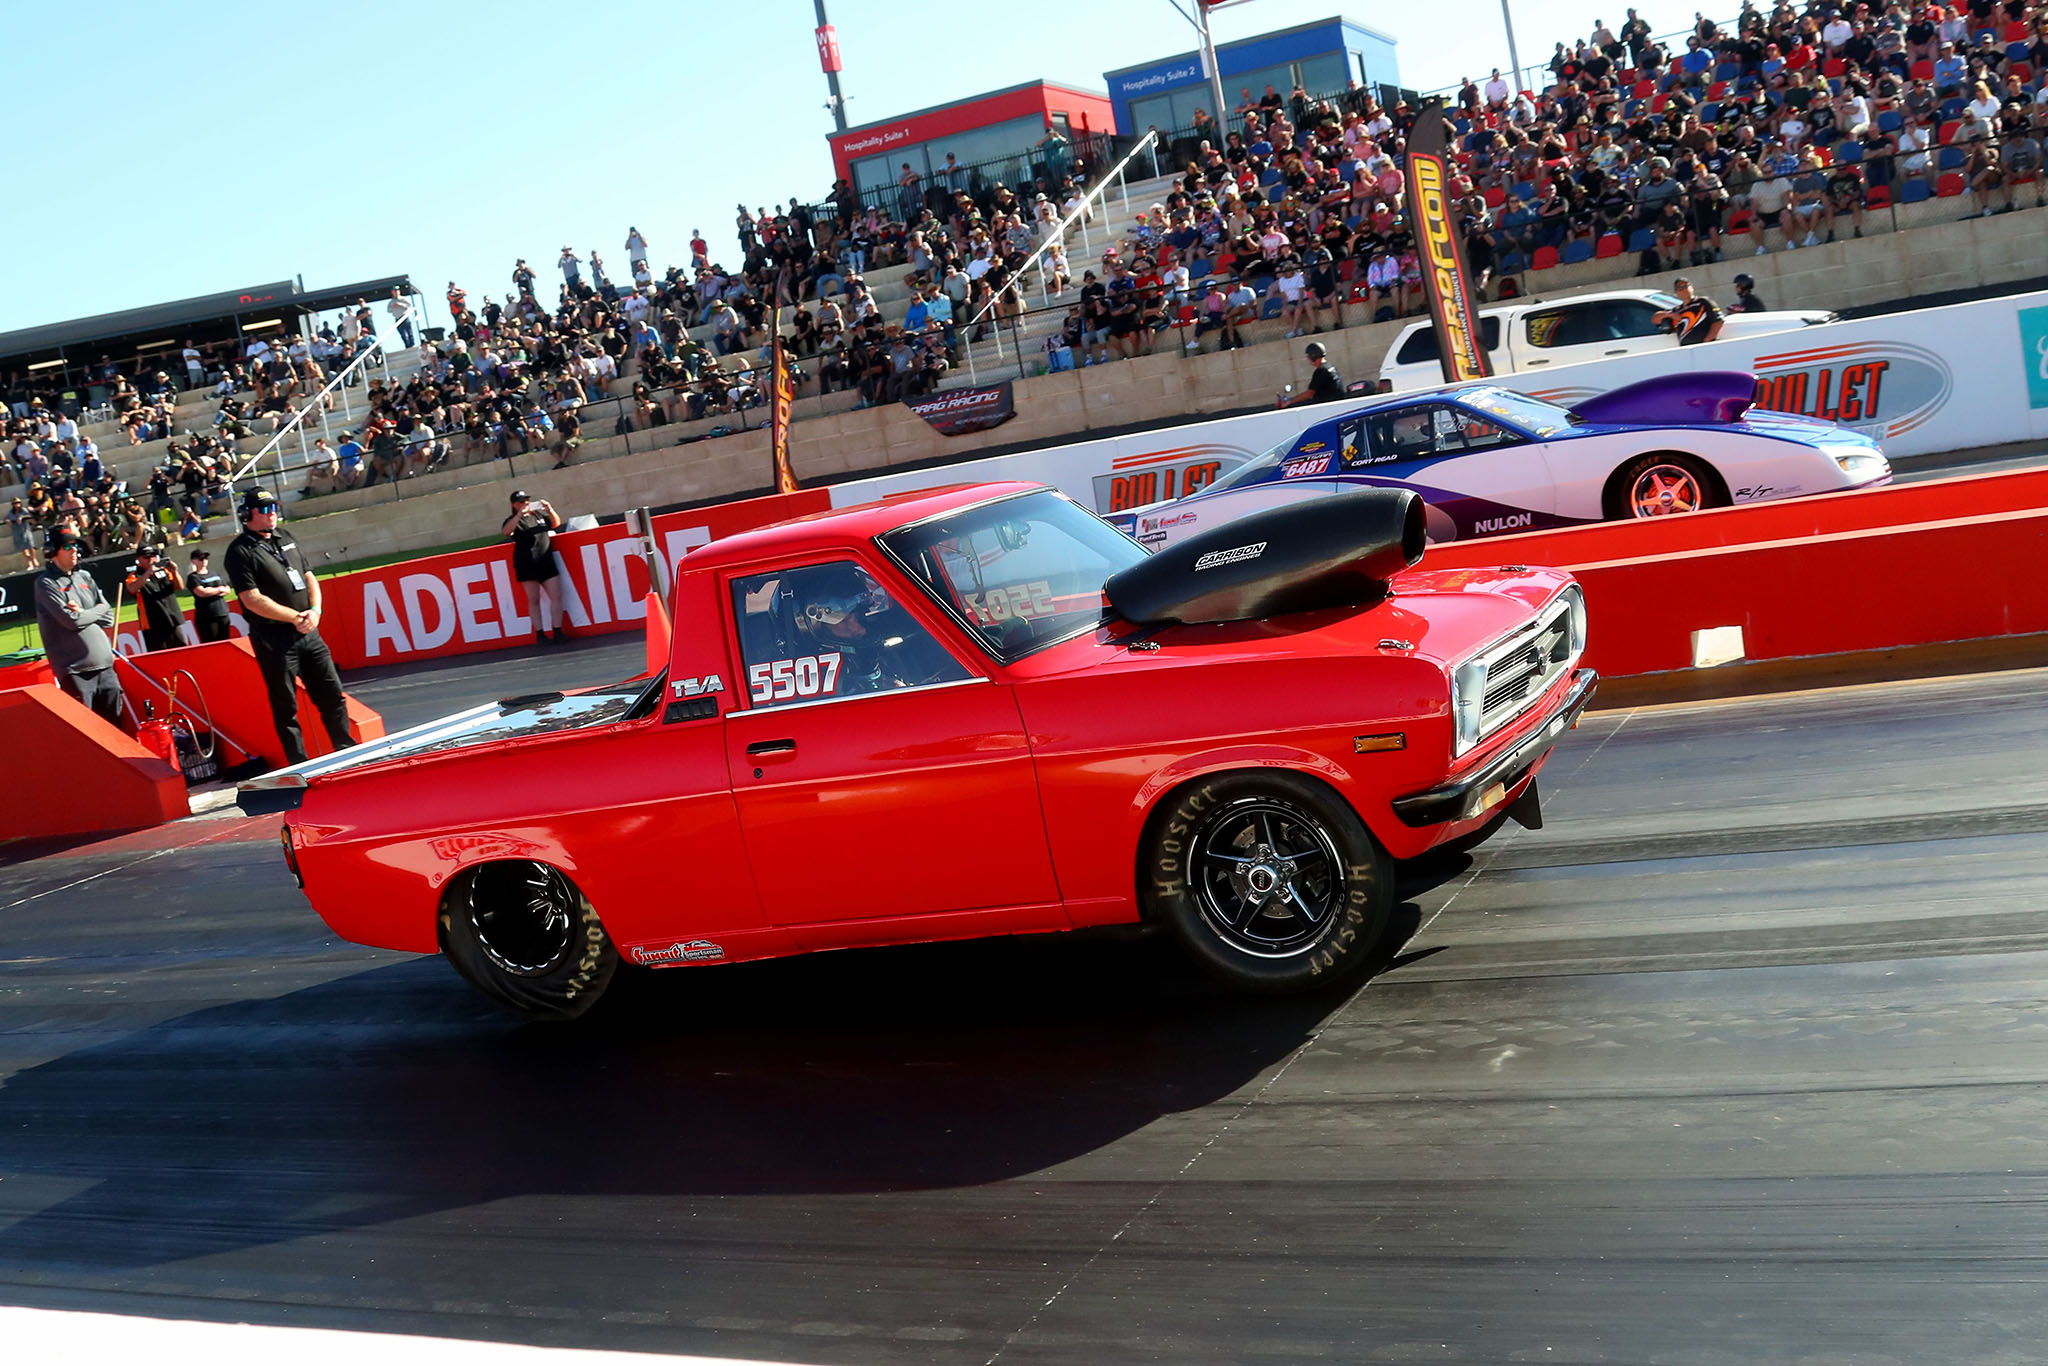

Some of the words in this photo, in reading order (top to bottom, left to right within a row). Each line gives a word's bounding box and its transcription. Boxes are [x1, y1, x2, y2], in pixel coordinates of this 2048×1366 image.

[1122, 74, 1166, 92] Hospitality
[1166, 70, 1188, 81] Suite
[1188, 66, 1196, 76] 2
[844, 136, 883, 152] Hospitality
[883, 131, 904, 143] Suite
[904, 128, 910, 137] 1
[1450, 270, 1465, 312] PRODUCTS
[1459, 312, 1478, 369] PERFORMANCE
[911, 401, 947, 414] DRAG
[947, 390, 1001, 408] RACING
[1755, 360, 1890, 423] BULLET
[1286, 458, 1330, 477] 6487
[1351, 458, 1374, 467] CORY
[1374, 454, 1398, 464] READ
[1735, 484, 1774, 498] R/T
[1475, 512, 1532, 534] NULON
[671, 674, 725, 698] TS/A
[750, 652, 843, 703] 5507
